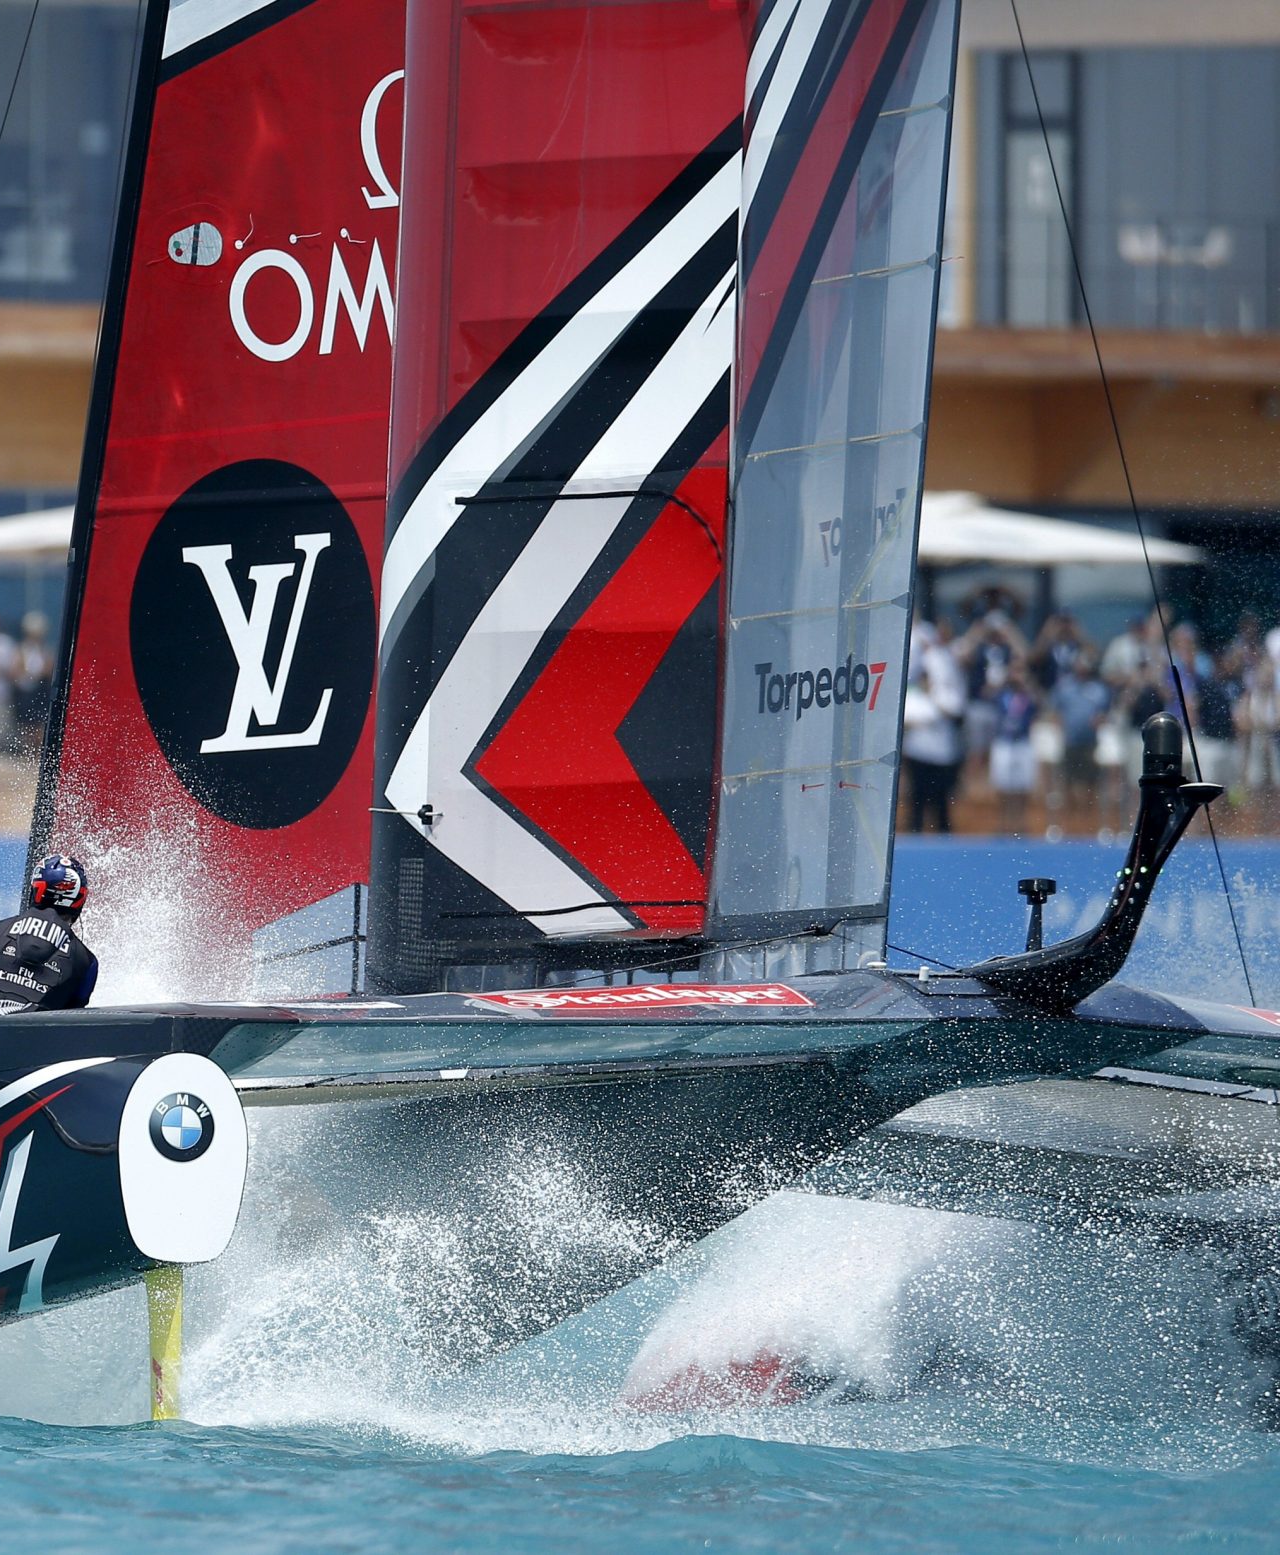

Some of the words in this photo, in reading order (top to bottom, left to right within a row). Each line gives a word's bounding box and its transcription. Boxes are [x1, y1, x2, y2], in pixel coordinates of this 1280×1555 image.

[754, 653, 888, 722] Torpedo7
[9, 916, 71, 954] BURLING
[19, 966, 35, 981] Fly
[156, 1094, 210, 1118] BMW
